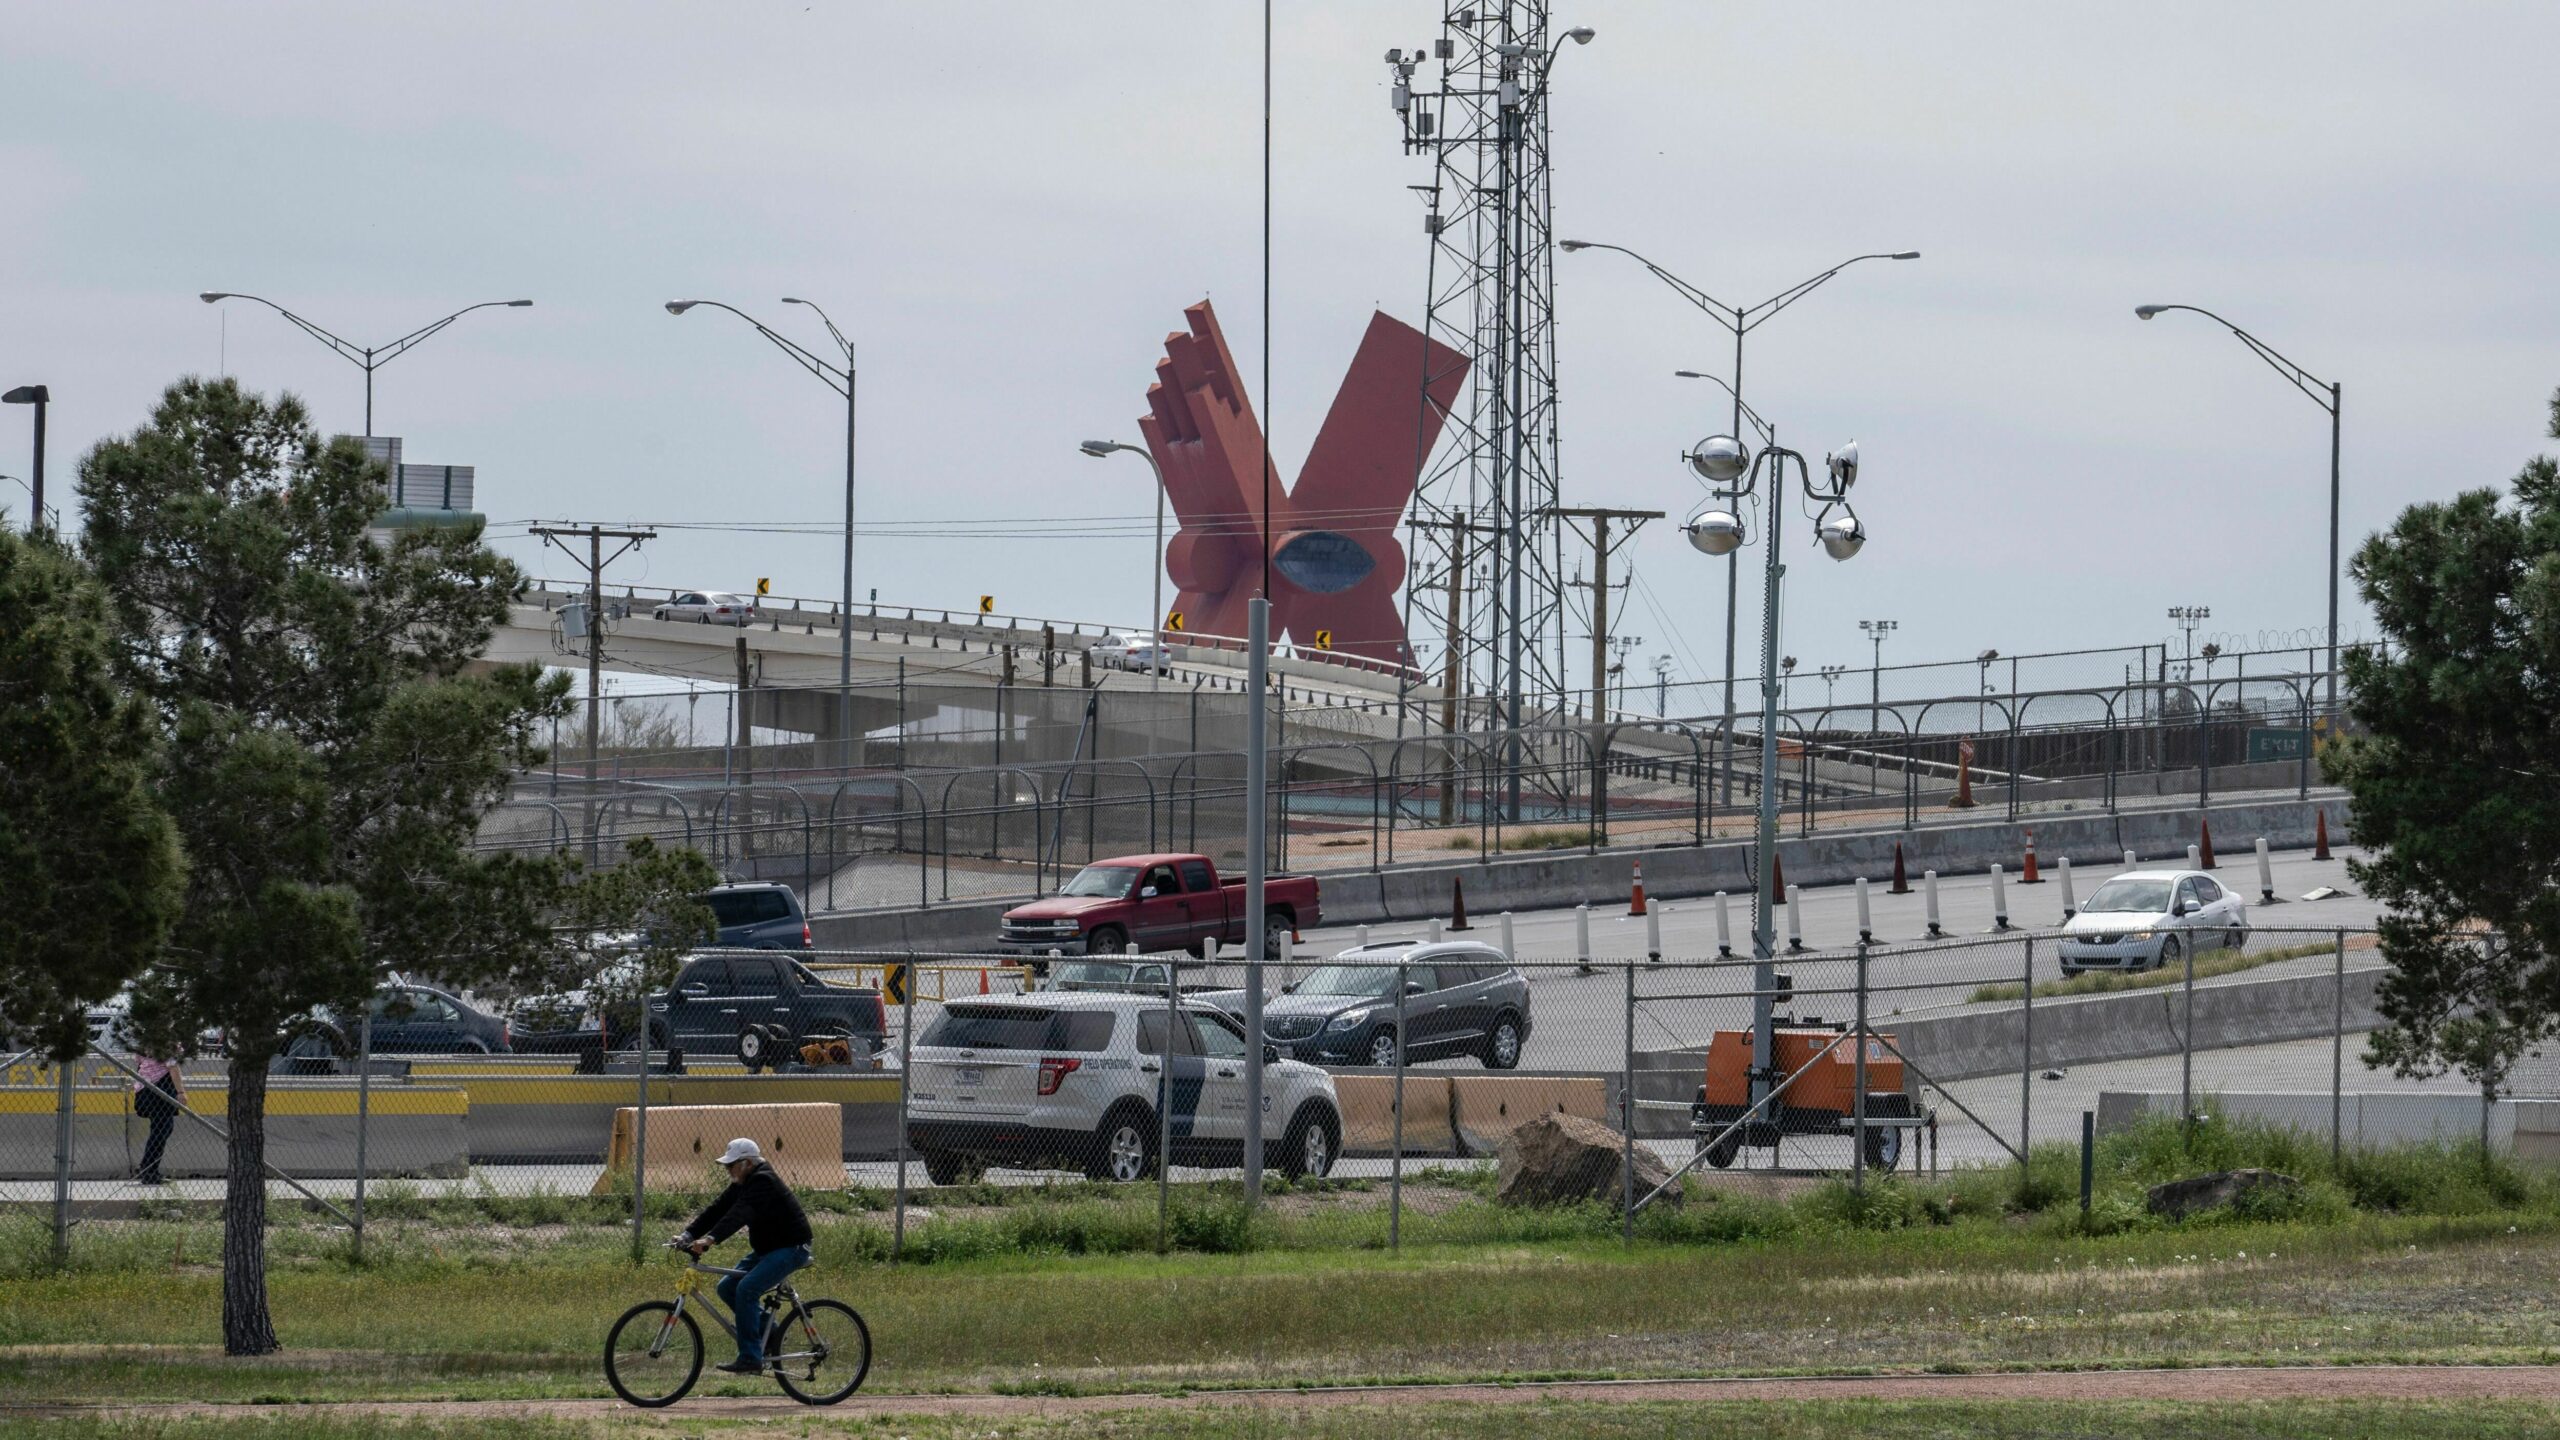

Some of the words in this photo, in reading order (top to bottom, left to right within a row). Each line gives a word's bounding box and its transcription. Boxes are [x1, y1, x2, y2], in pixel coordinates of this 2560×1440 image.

[2261, 738, 2299, 752] EXIT
[1083, 1059, 1099, 1070] FIELD
[1100, 1059, 1133, 1070] OPERATIONS
